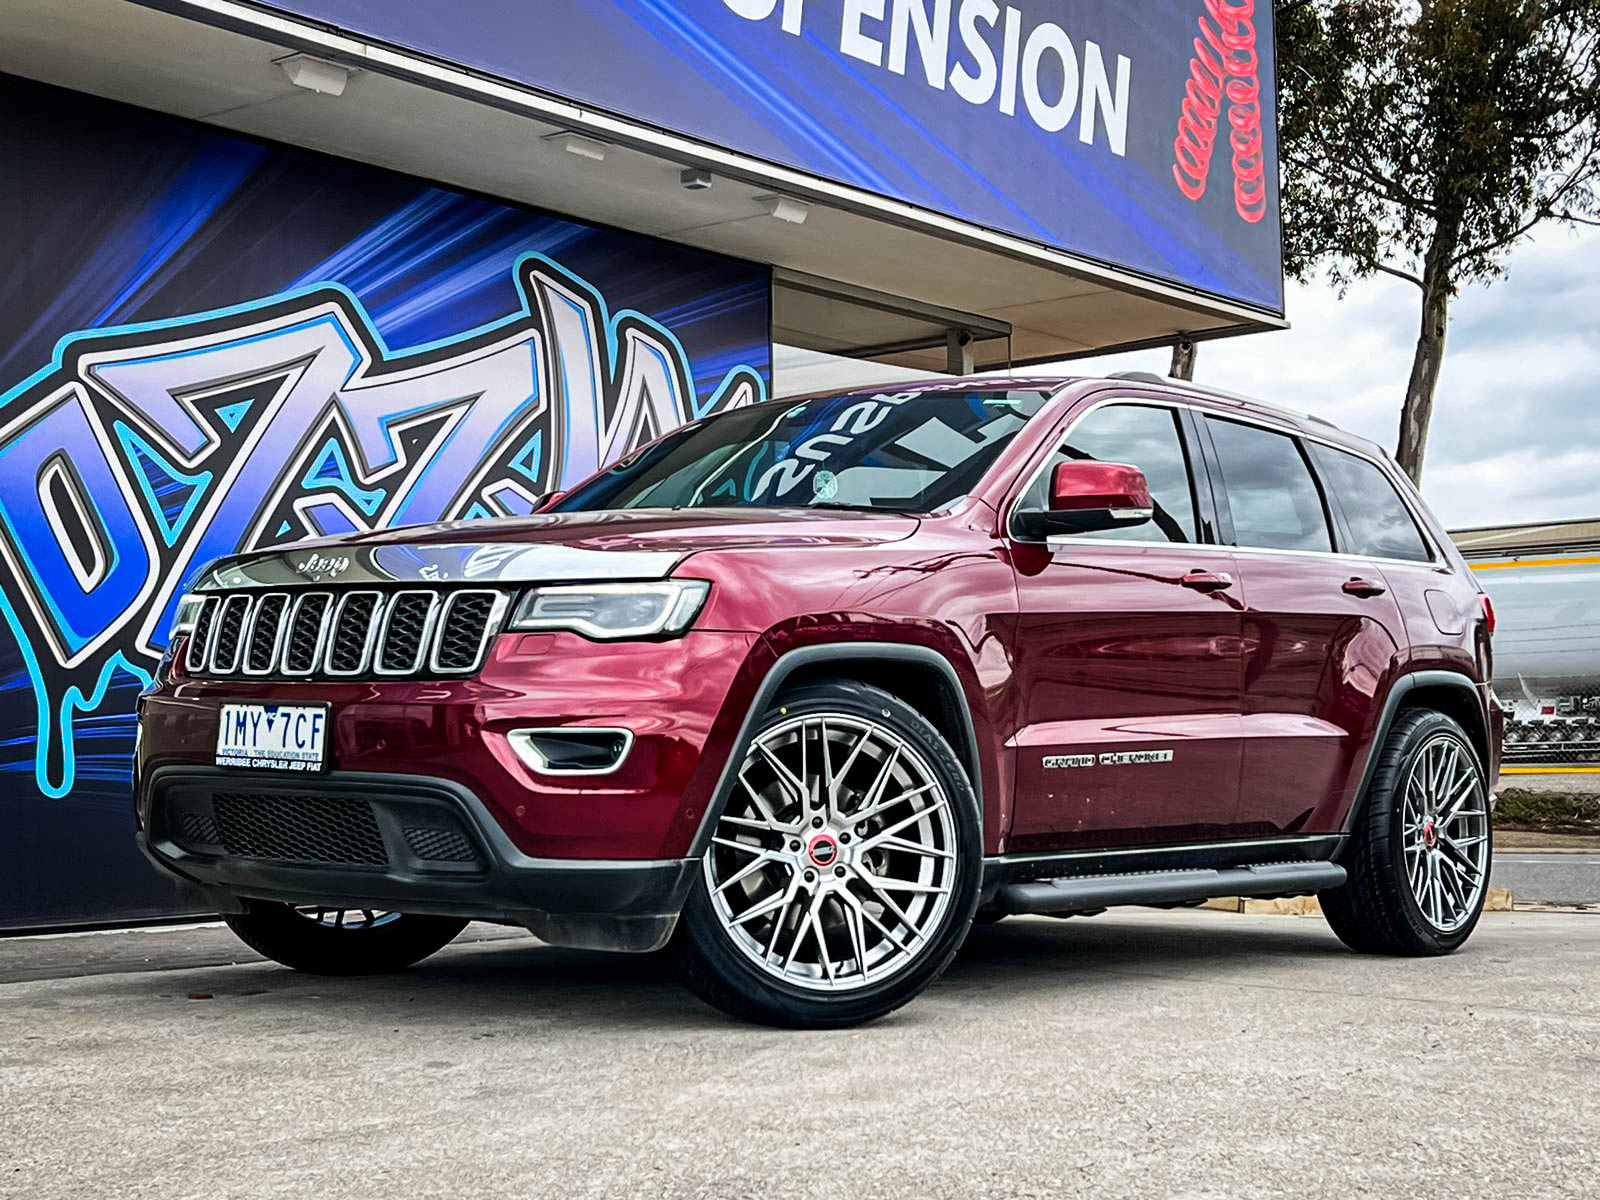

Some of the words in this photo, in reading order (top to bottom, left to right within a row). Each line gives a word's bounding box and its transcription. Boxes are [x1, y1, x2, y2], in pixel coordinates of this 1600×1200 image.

[723, 0, 1131, 157] ENSION
[224, 710, 262, 747] 1MY
[280, 711, 324, 750] 7CF
[215, 756, 251, 767] WERRIBEE
[251, 758, 289, 769] CHRYSLER
[288, 761, 306, 770] JEEP
[306, 762, 322, 771] FIAT
